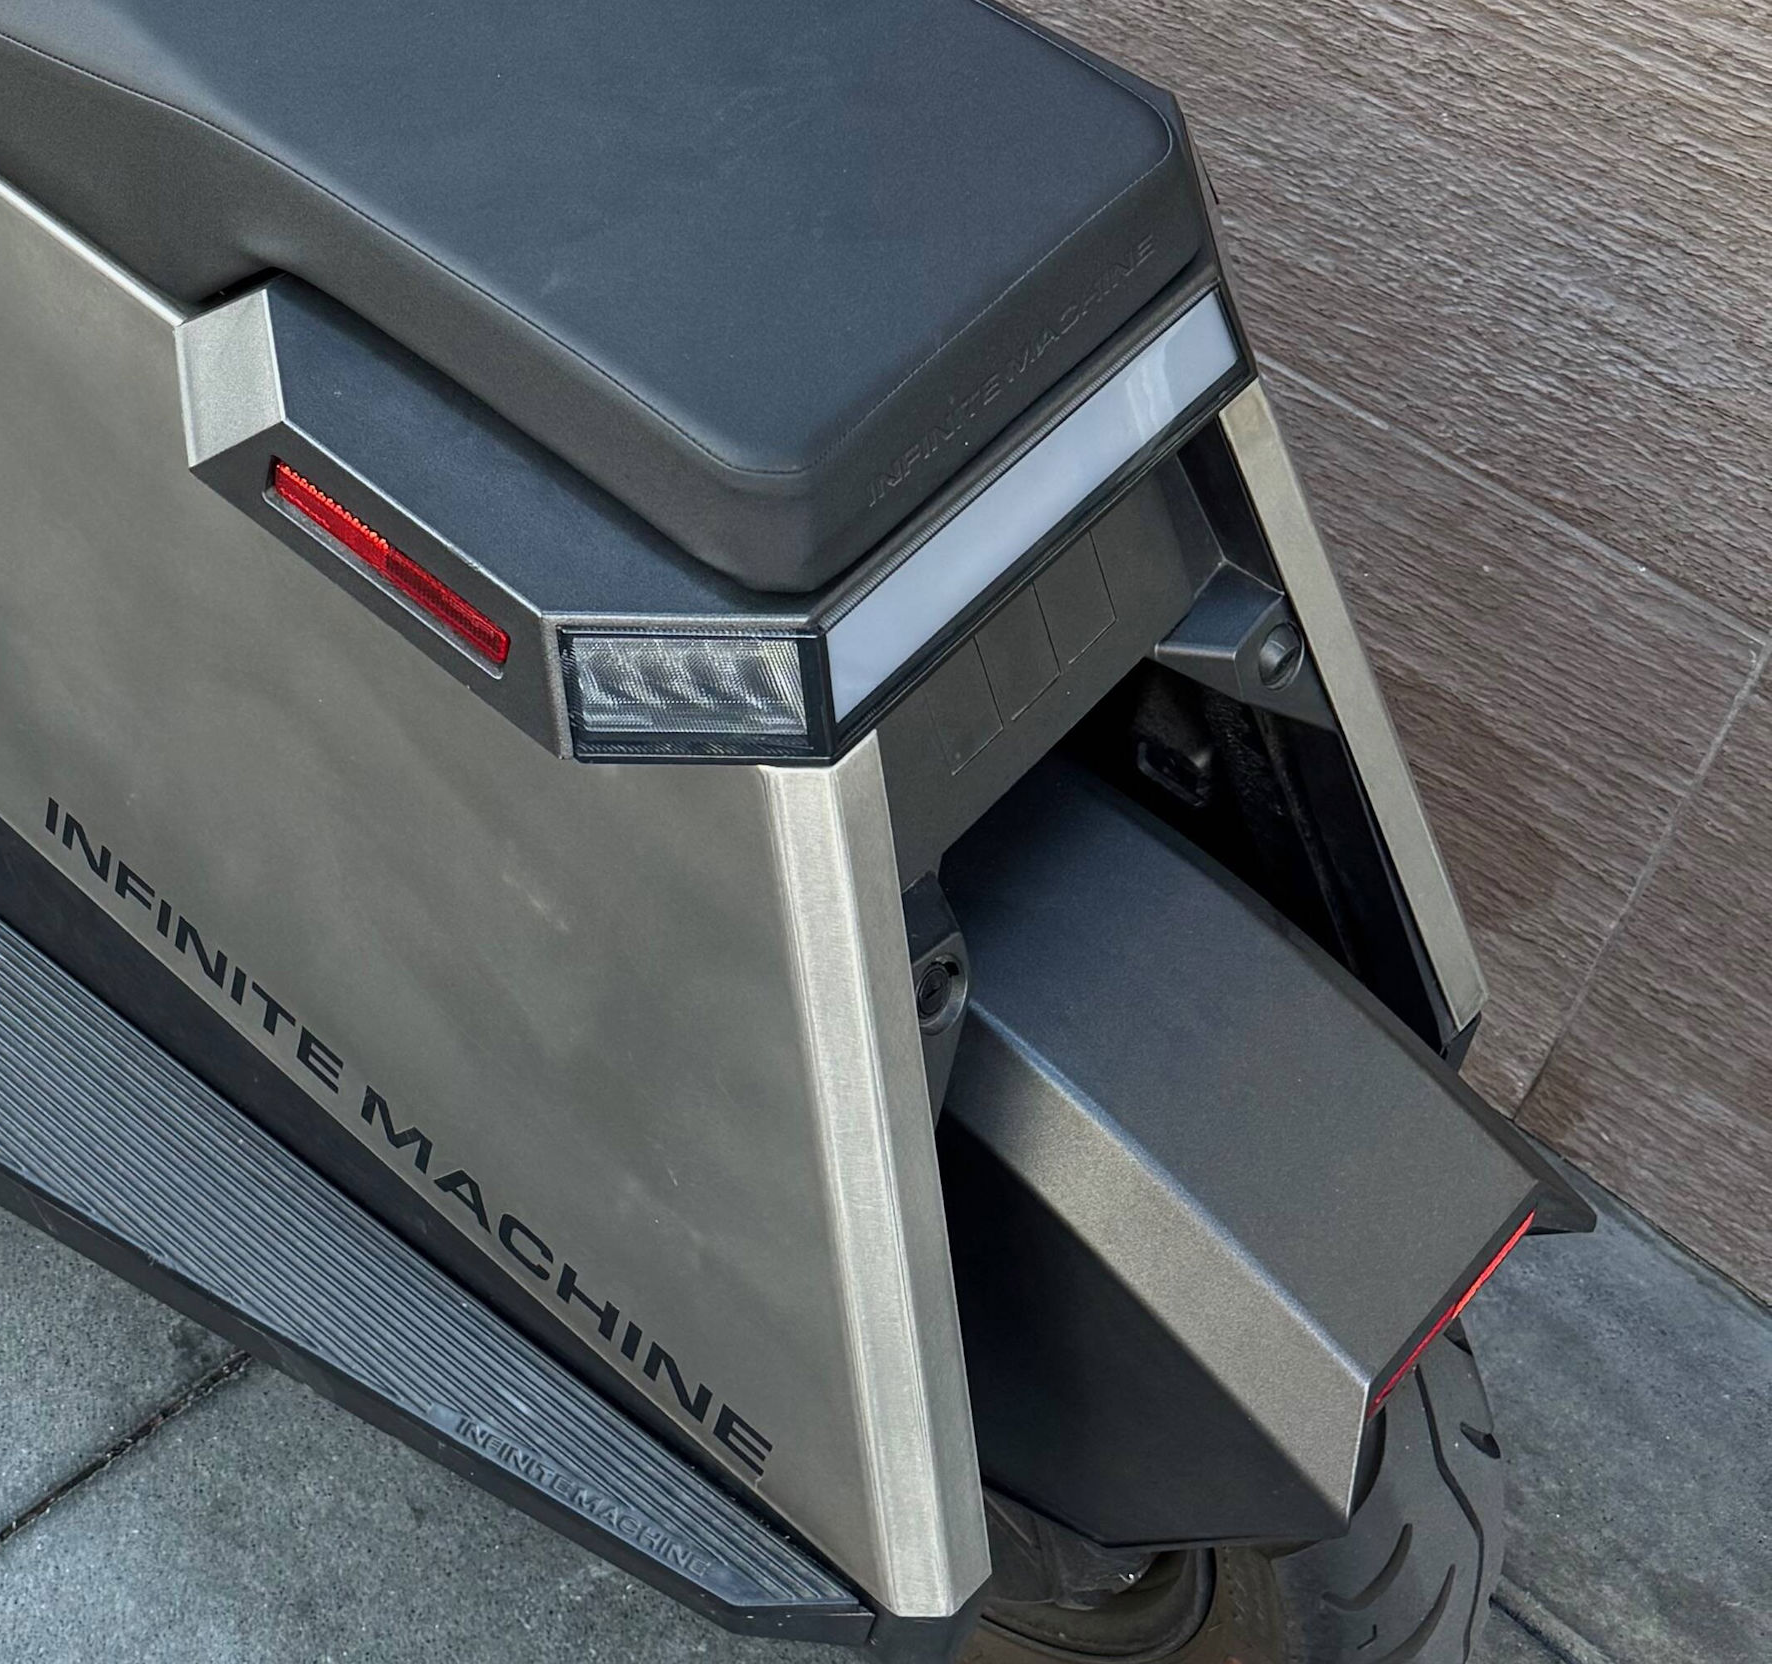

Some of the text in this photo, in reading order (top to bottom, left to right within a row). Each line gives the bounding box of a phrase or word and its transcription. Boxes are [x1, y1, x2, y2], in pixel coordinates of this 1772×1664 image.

[44, 796, 774, 1478] INFINITE MACHINE
[457, 1417, 710, 1577] INFINITE MACHINE
